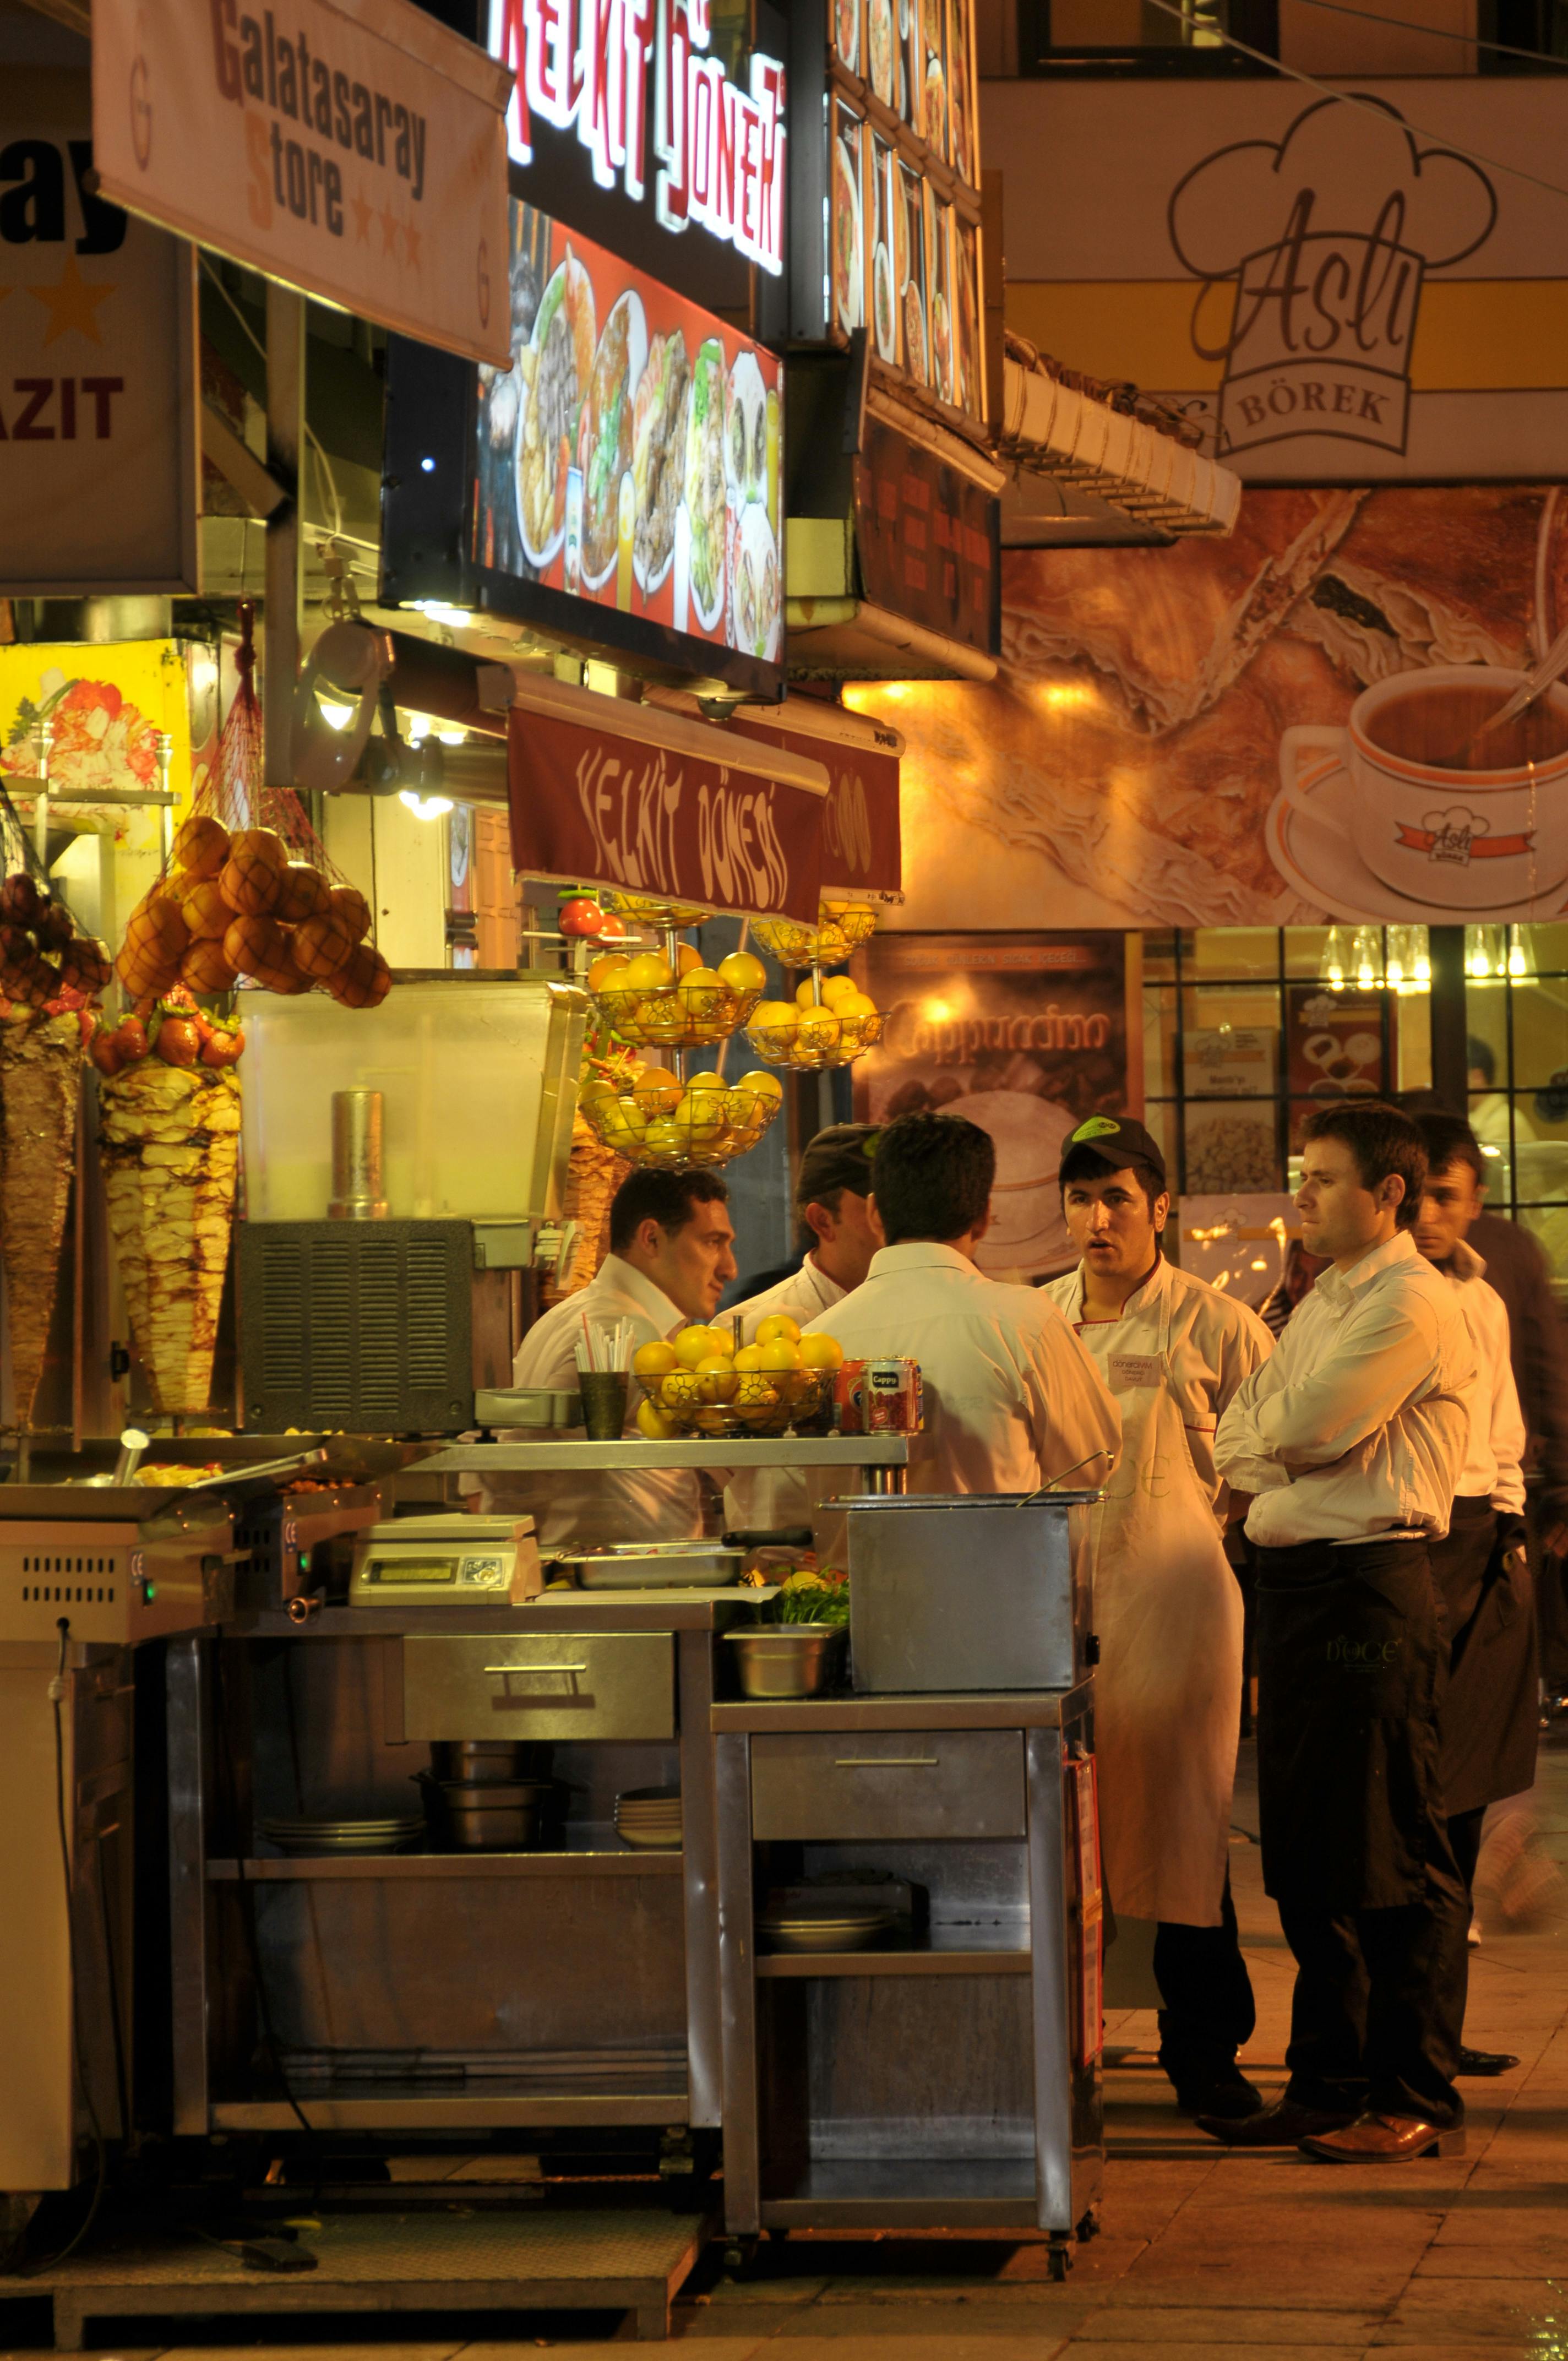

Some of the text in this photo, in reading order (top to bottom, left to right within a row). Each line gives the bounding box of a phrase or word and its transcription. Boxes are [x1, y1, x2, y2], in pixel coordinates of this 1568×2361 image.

[210, 0, 426, 201] Galatasaray
[245, 111, 344, 237] Store
[0, 377, 123, 441] ZIT
[1237, 377, 1391, 427] BÖREK
[883, 998, 1111, 1065] Cappuccino
[873, 1375, 896, 1385] Cappy
